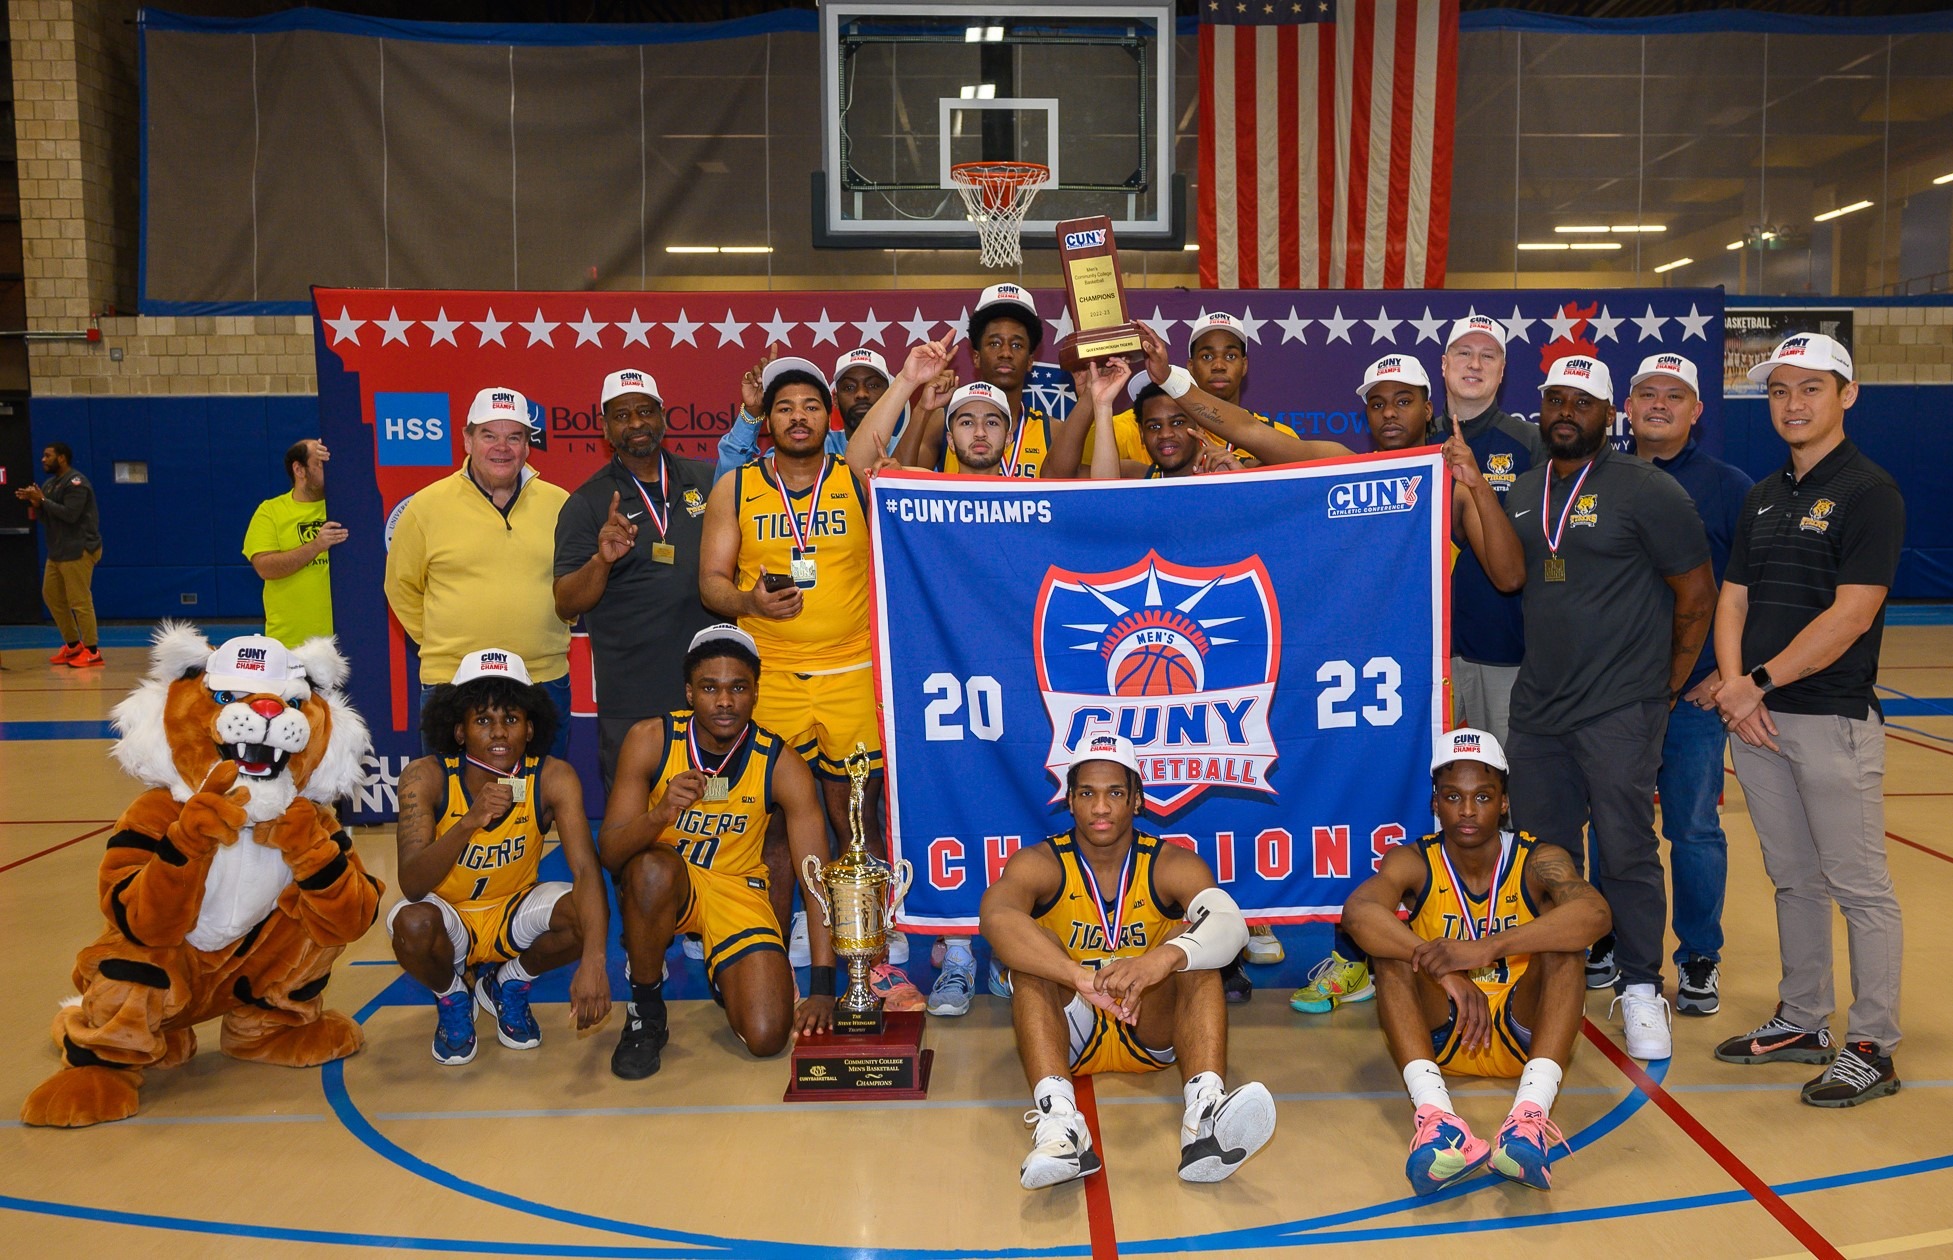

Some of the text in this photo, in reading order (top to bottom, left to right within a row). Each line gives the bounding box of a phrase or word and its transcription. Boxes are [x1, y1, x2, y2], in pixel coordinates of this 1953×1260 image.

[1066, 230, 1106, 248] CUNY
[1097, 271, 1112, 279] College
[997, 286, 1019, 294] CUNY
[1079, 293, 1116, 303] CHAMPIONS
[1209, 313, 1231, 321] CUNY
[1470, 317, 1492, 325] CUNY
[1469, 323, 1492, 331] CHAMPS
[1086, 344, 1120, 353] QUEENSBOROUGH
[1782, 338, 1810, 350] CUNY
[850, 349, 872, 357] CUNY
[1778, 348, 1806, 359] CHAMPS
[1378, 358, 1401, 369] CUNY
[1566, 359, 1593, 370] CUNY
[1657, 356, 1683, 366] CUNY
[1376, 367, 1401, 376] CHAMPS
[1655, 363, 1681, 373] CHAMPS
[620, 372, 643, 381] CUNY
[1563, 369, 1590, 379] CHAMPS
[969, 383, 992, 391] CUNY
[491, 393, 515, 402] CUNY
[492, 402, 516, 411] CHAMPS
[385, 418, 443, 441] HSS
[1329, 476, 1422, 510] CUNY
[389, 500, 410, 530] UNIVER
[886, 498, 1052, 523] #CUNYCHAMPS
[1332, 503, 1405, 516] ATHLETIC CONFERENCE
[753, 509, 847, 542] TIGERS
[1136, 631, 1175, 645] MEN'S
[237, 648, 267, 660] CUNY
[481, 652, 507, 662] CUNY
[236, 663, 265, 671] CHAMPS
[1316, 656, 1403, 729] 23
[922, 671, 1004, 742] 20
[1063, 696, 1260, 755] CUNY
[1091, 736, 1117, 745] CUNY
[1454, 734, 1480, 744] CUNY
[1090, 745, 1117, 753] CHAMPS
[1453, 746, 1481, 754] CHAMPS
[360, 755, 410, 786] CU
[1136, 757, 1257, 785] KETBALL
[675, 808, 749, 837] IGERS
[457, 834, 527, 871] IGERS
[675, 837, 721, 870] 10
[928, 822, 1407, 891] CHIONS
[469, 876, 490, 901] 1
